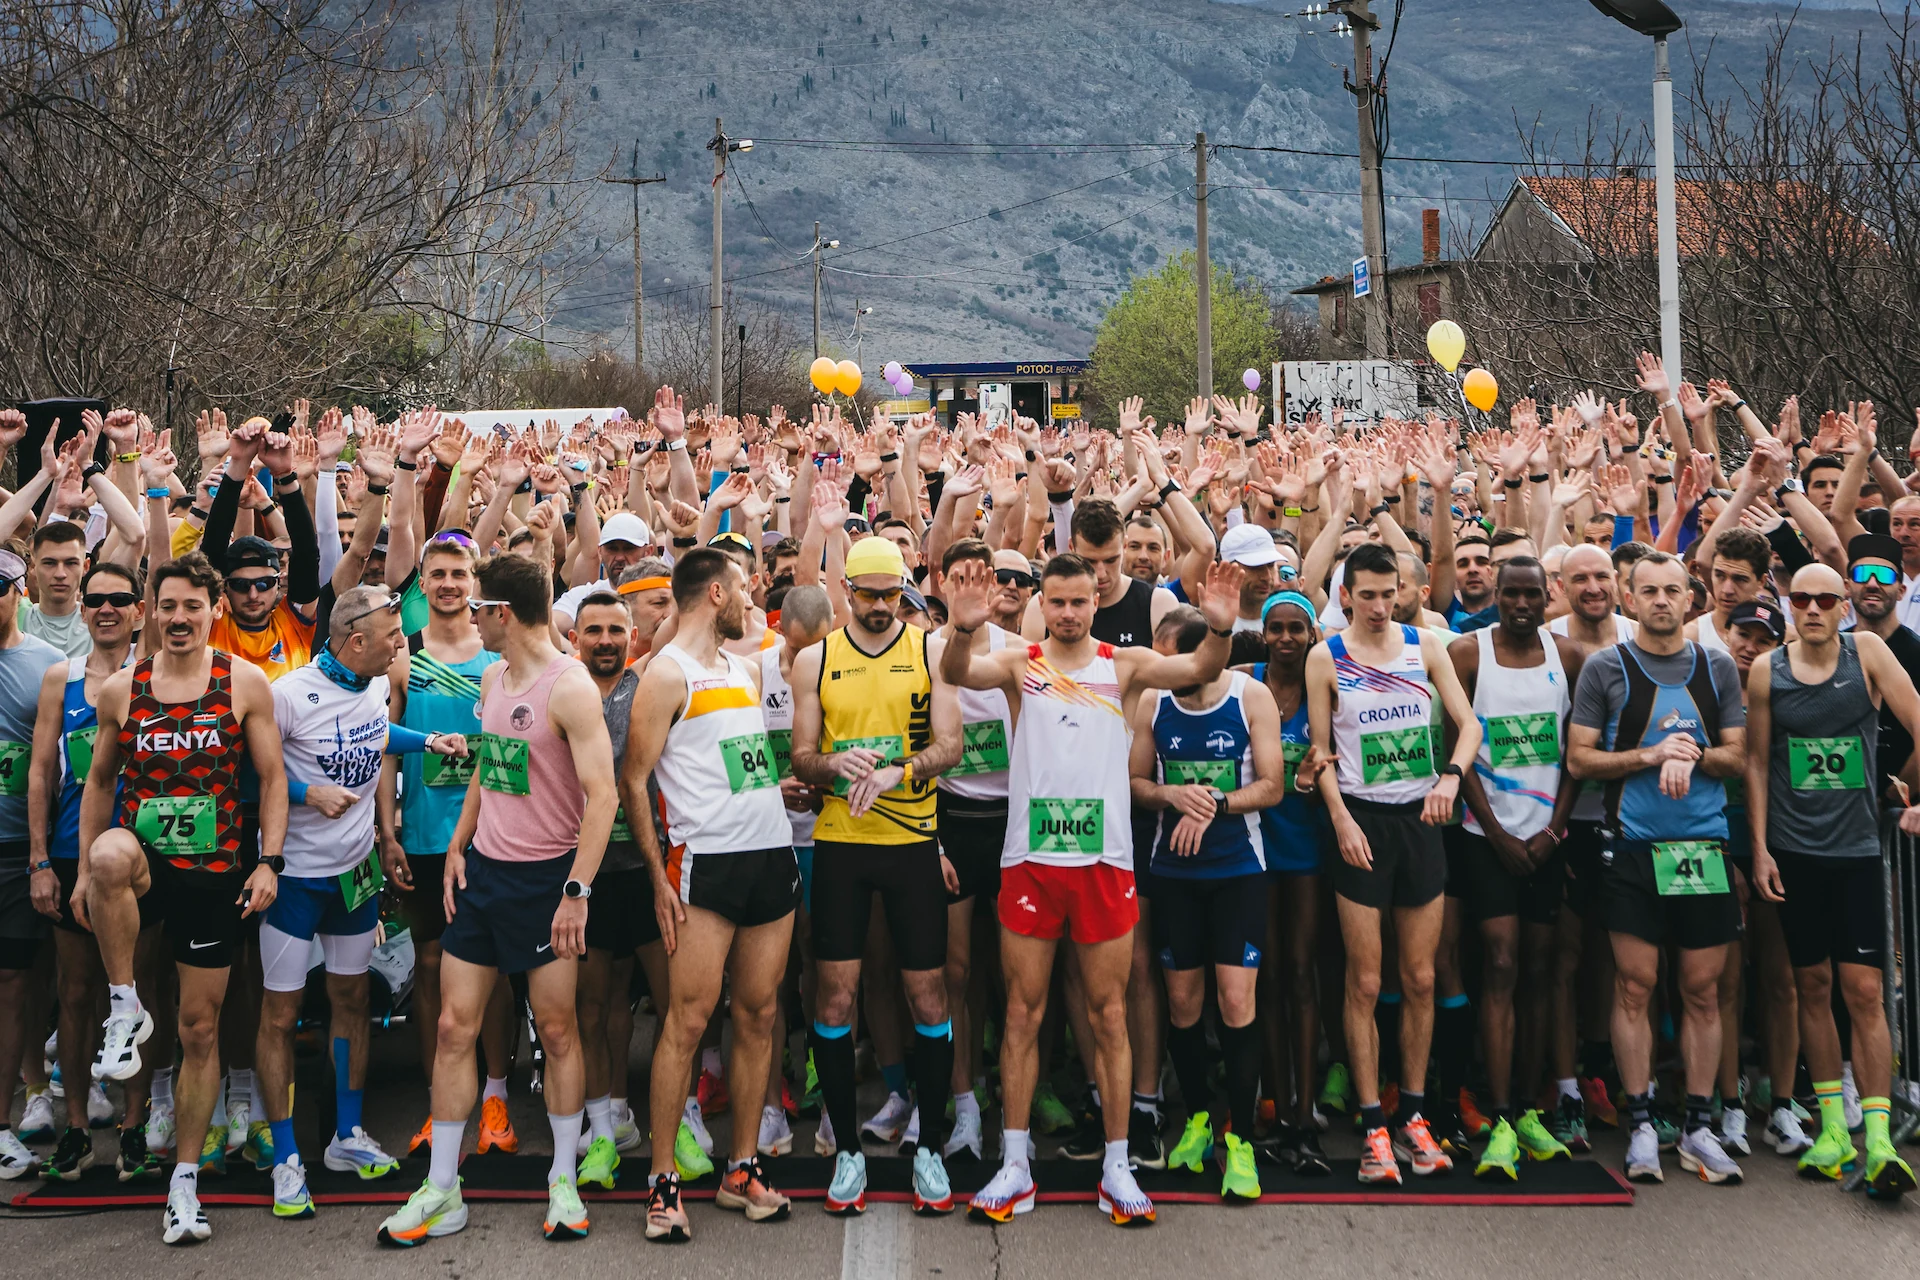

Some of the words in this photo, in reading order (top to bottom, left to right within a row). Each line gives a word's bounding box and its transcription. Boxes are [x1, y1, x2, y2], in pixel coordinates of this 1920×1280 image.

[1016, 365, 1053, 374] POTOCI
[1359, 703, 1421, 724] CROATIA
[136, 729, 222, 752] KENYA
[908, 692, 931, 795] SNUS
[1494, 733, 1554, 747] KIPROTICH
[323, 744, 365, 766] 5000
[440, 748, 477, 769] 42
[482, 756, 523, 773] STOJANOVIĆ
[741, 749, 769, 773] 84
[1366, 747, 1427, 767] DRAČAR
[1807, 753, 1846, 774] 20
[157, 814, 196, 837] 75
[1037, 816, 1096, 836] JUKIĆ
[352, 859, 373, 886] 44
[1675, 858, 1705, 879] 41
